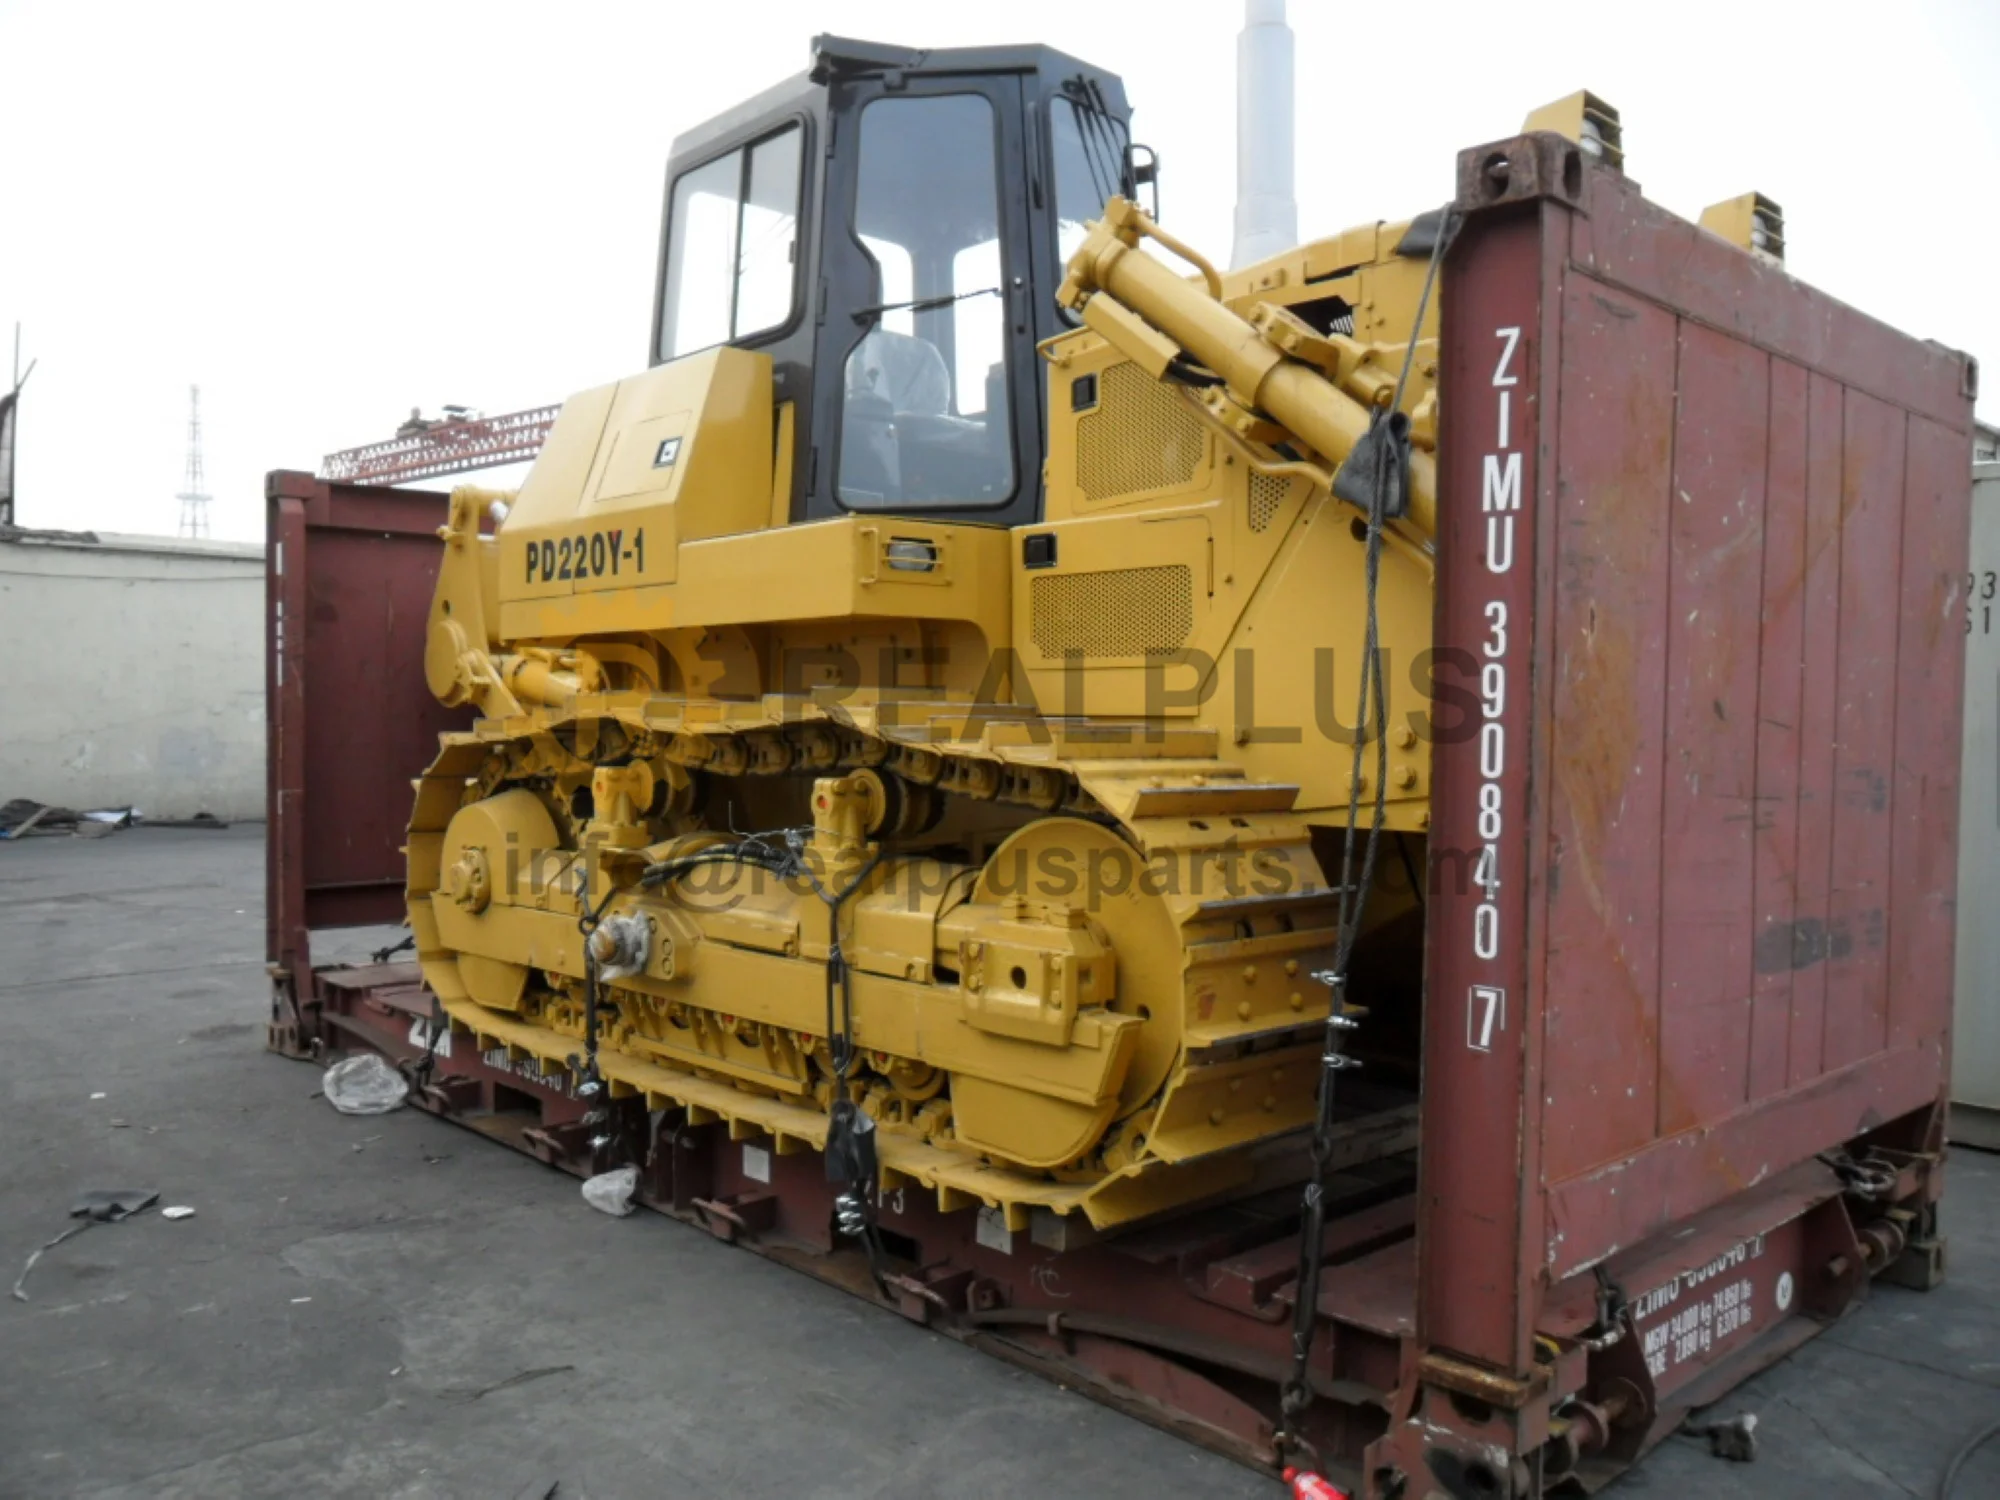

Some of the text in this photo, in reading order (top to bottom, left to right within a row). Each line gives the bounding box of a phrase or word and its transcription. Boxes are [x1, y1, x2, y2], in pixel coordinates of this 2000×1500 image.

[526, 527, 644, 583] PD220Y-1
[1473, 327, 1522, 1049] ZIMU 390840 7
